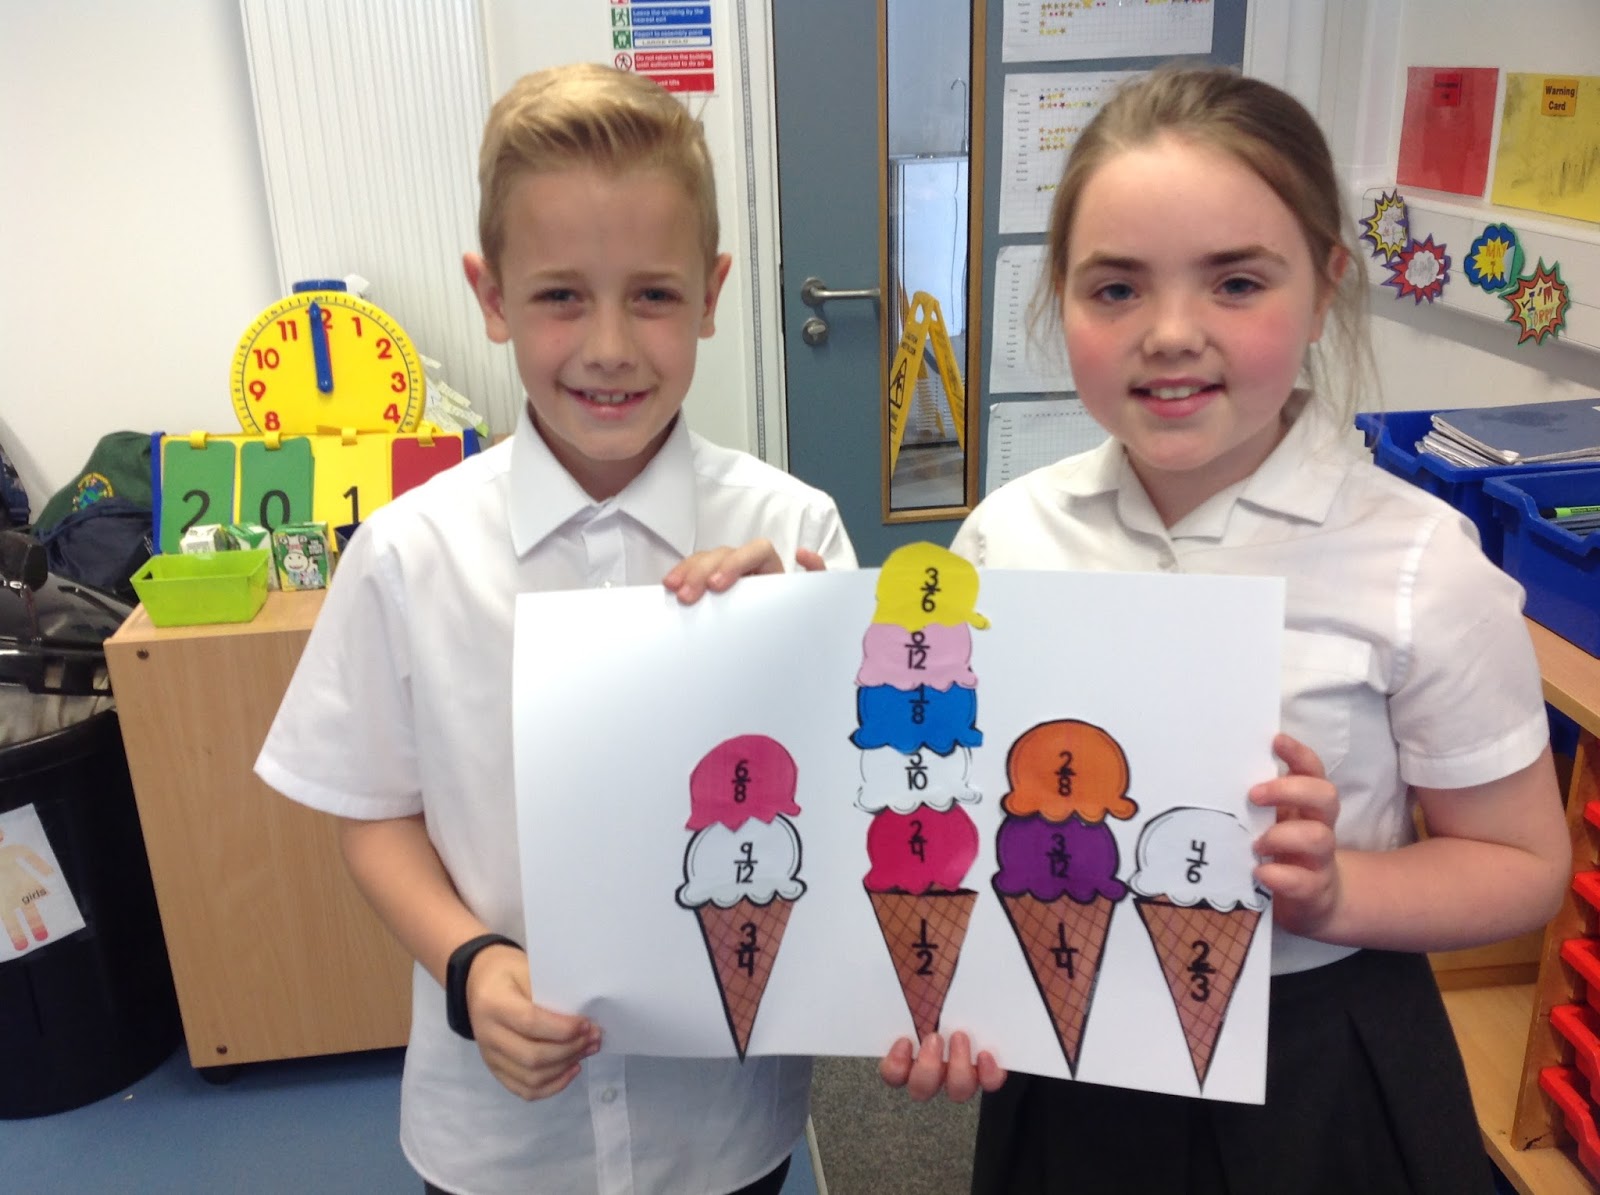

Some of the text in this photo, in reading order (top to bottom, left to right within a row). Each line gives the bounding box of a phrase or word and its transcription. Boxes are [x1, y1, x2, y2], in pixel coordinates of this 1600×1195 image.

[662, 8, 685, 16] building
[1545, 85, 1576, 98] Warning
[1548, 101, 1566, 111] Card
[305, 308, 333, 330] 2
[352, 317, 363, 337] 1
[277, 320, 298, 341] 11
[253, 348, 280, 370] 10
[375, 338, 392, 359] 2
[249, 380, 266, 402] 9
[390, 371, 407, 393] 3
[264, 411, 280, 431] 8
[383, 403, 401, 424] 4
[180, 486, 360, 534] 2 0 1
[925, 567, 939, 588] 3
[921, 592, 936, 613] 6
[908, 648, 927, 670] 12
[912, 703, 925, 725] 8
[735, 760, 749, 780] 6
[1058, 751, 1074, 773] 2
[908, 769, 928, 790] 10
[1058, 776, 1072, 797] 8
[734, 781, 747, 803] 8
[909, 820, 923, 840] 2
[741, 841, 753, 863] 9
[1051, 833, 1066, 853] 3
[1191, 839, 1206, 863] 4
[736, 863, 754, 884] 12
[1051, 856, 1069, 878] 12
[1186, 863, 1202, 884] 6
[21, 887, 47, 905] girls
[740, 921, 757, 948] 3
[921, 918, 927, 945] 1
[737, 948, 754, 978] 4
[916, 950, 934, 976] 2
[1190, 940, 1210, 967] 2
[1055, 950, 1075, 980] 4
[1190, 973, 1210, 1002] 3
